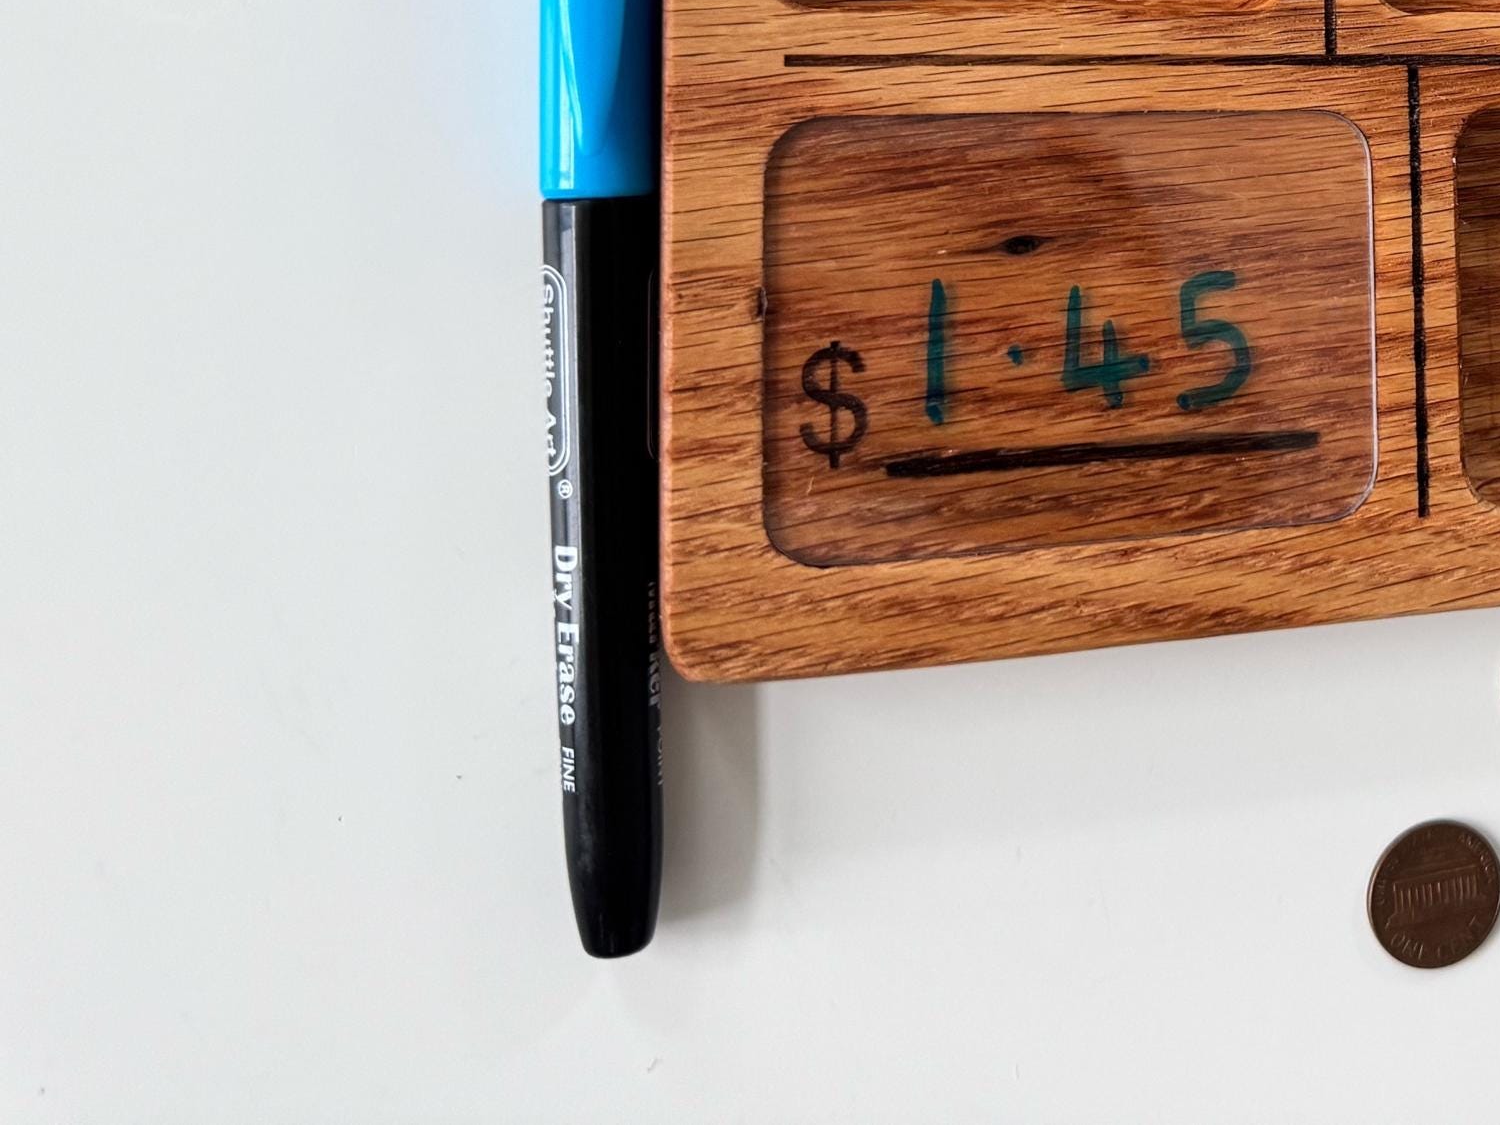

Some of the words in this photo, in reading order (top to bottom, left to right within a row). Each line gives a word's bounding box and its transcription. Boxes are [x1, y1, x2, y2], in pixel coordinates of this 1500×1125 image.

[798, 340, 869, 469] $
[553, 545, 579, 611] Dry
[556, 622, 580, 726] Erase
[560, 746, 576, 795] FINE
